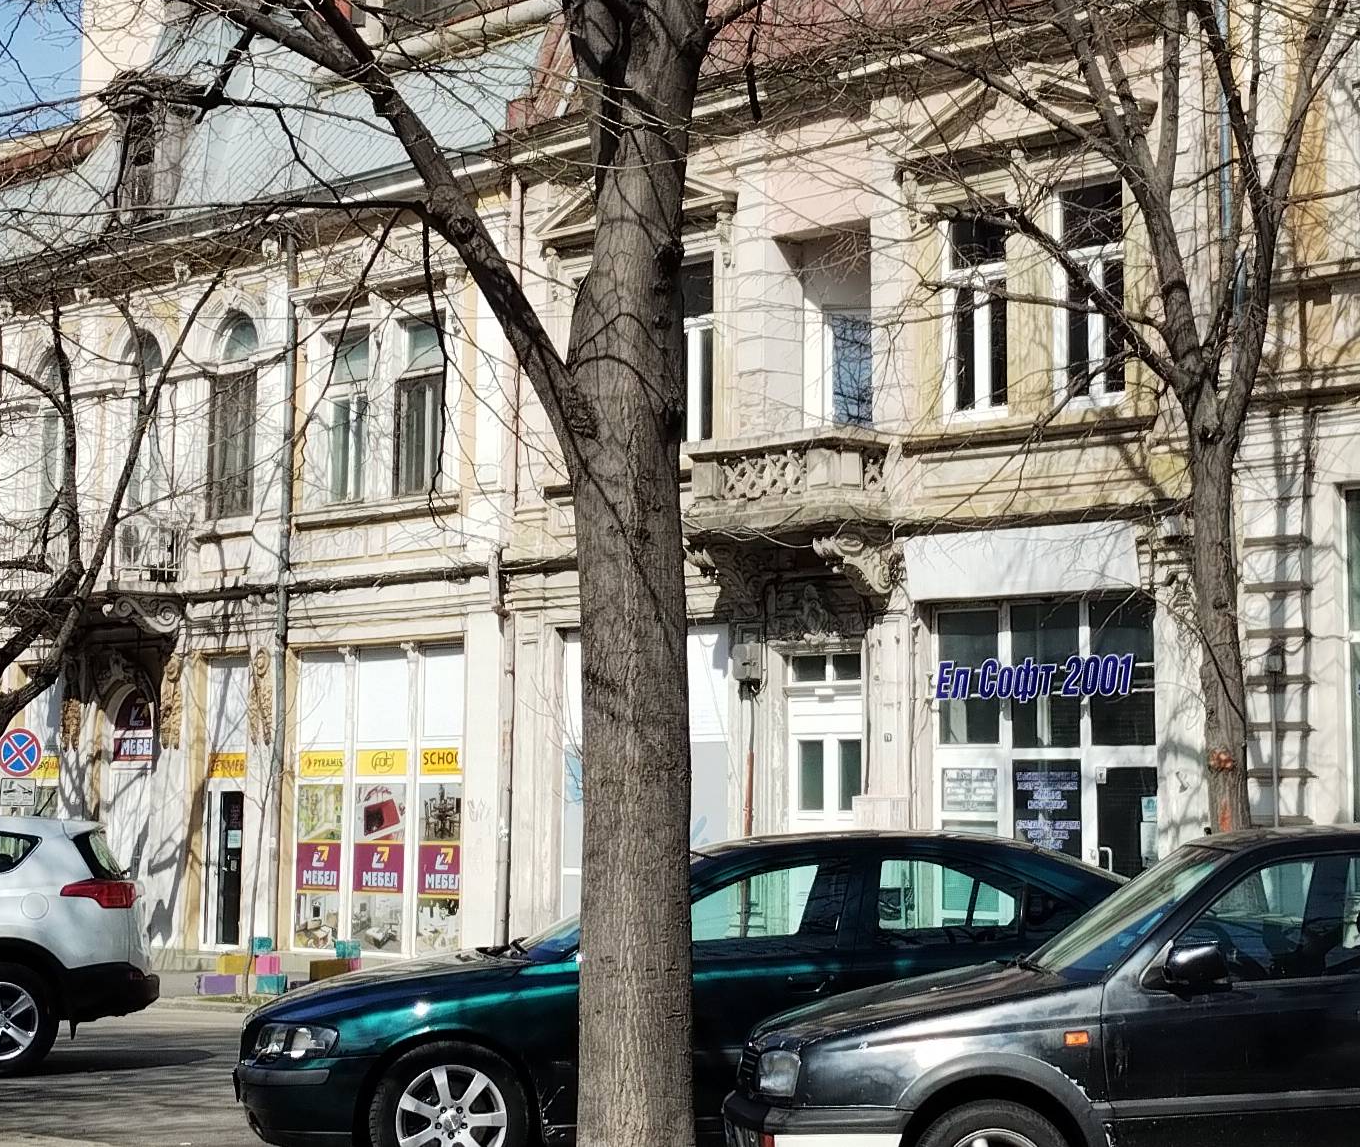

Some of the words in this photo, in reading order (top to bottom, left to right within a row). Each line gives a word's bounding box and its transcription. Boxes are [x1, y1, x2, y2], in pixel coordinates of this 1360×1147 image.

[978, 657, 1056, 704] Софт
[1061, 653, 1135, 697] 2001
[120, 739, 152, 755] МЕБЕ
[303, 870, 337, 886] МЕБЕЛ
[362, 871, 397, 887] МЕБЕЛ
